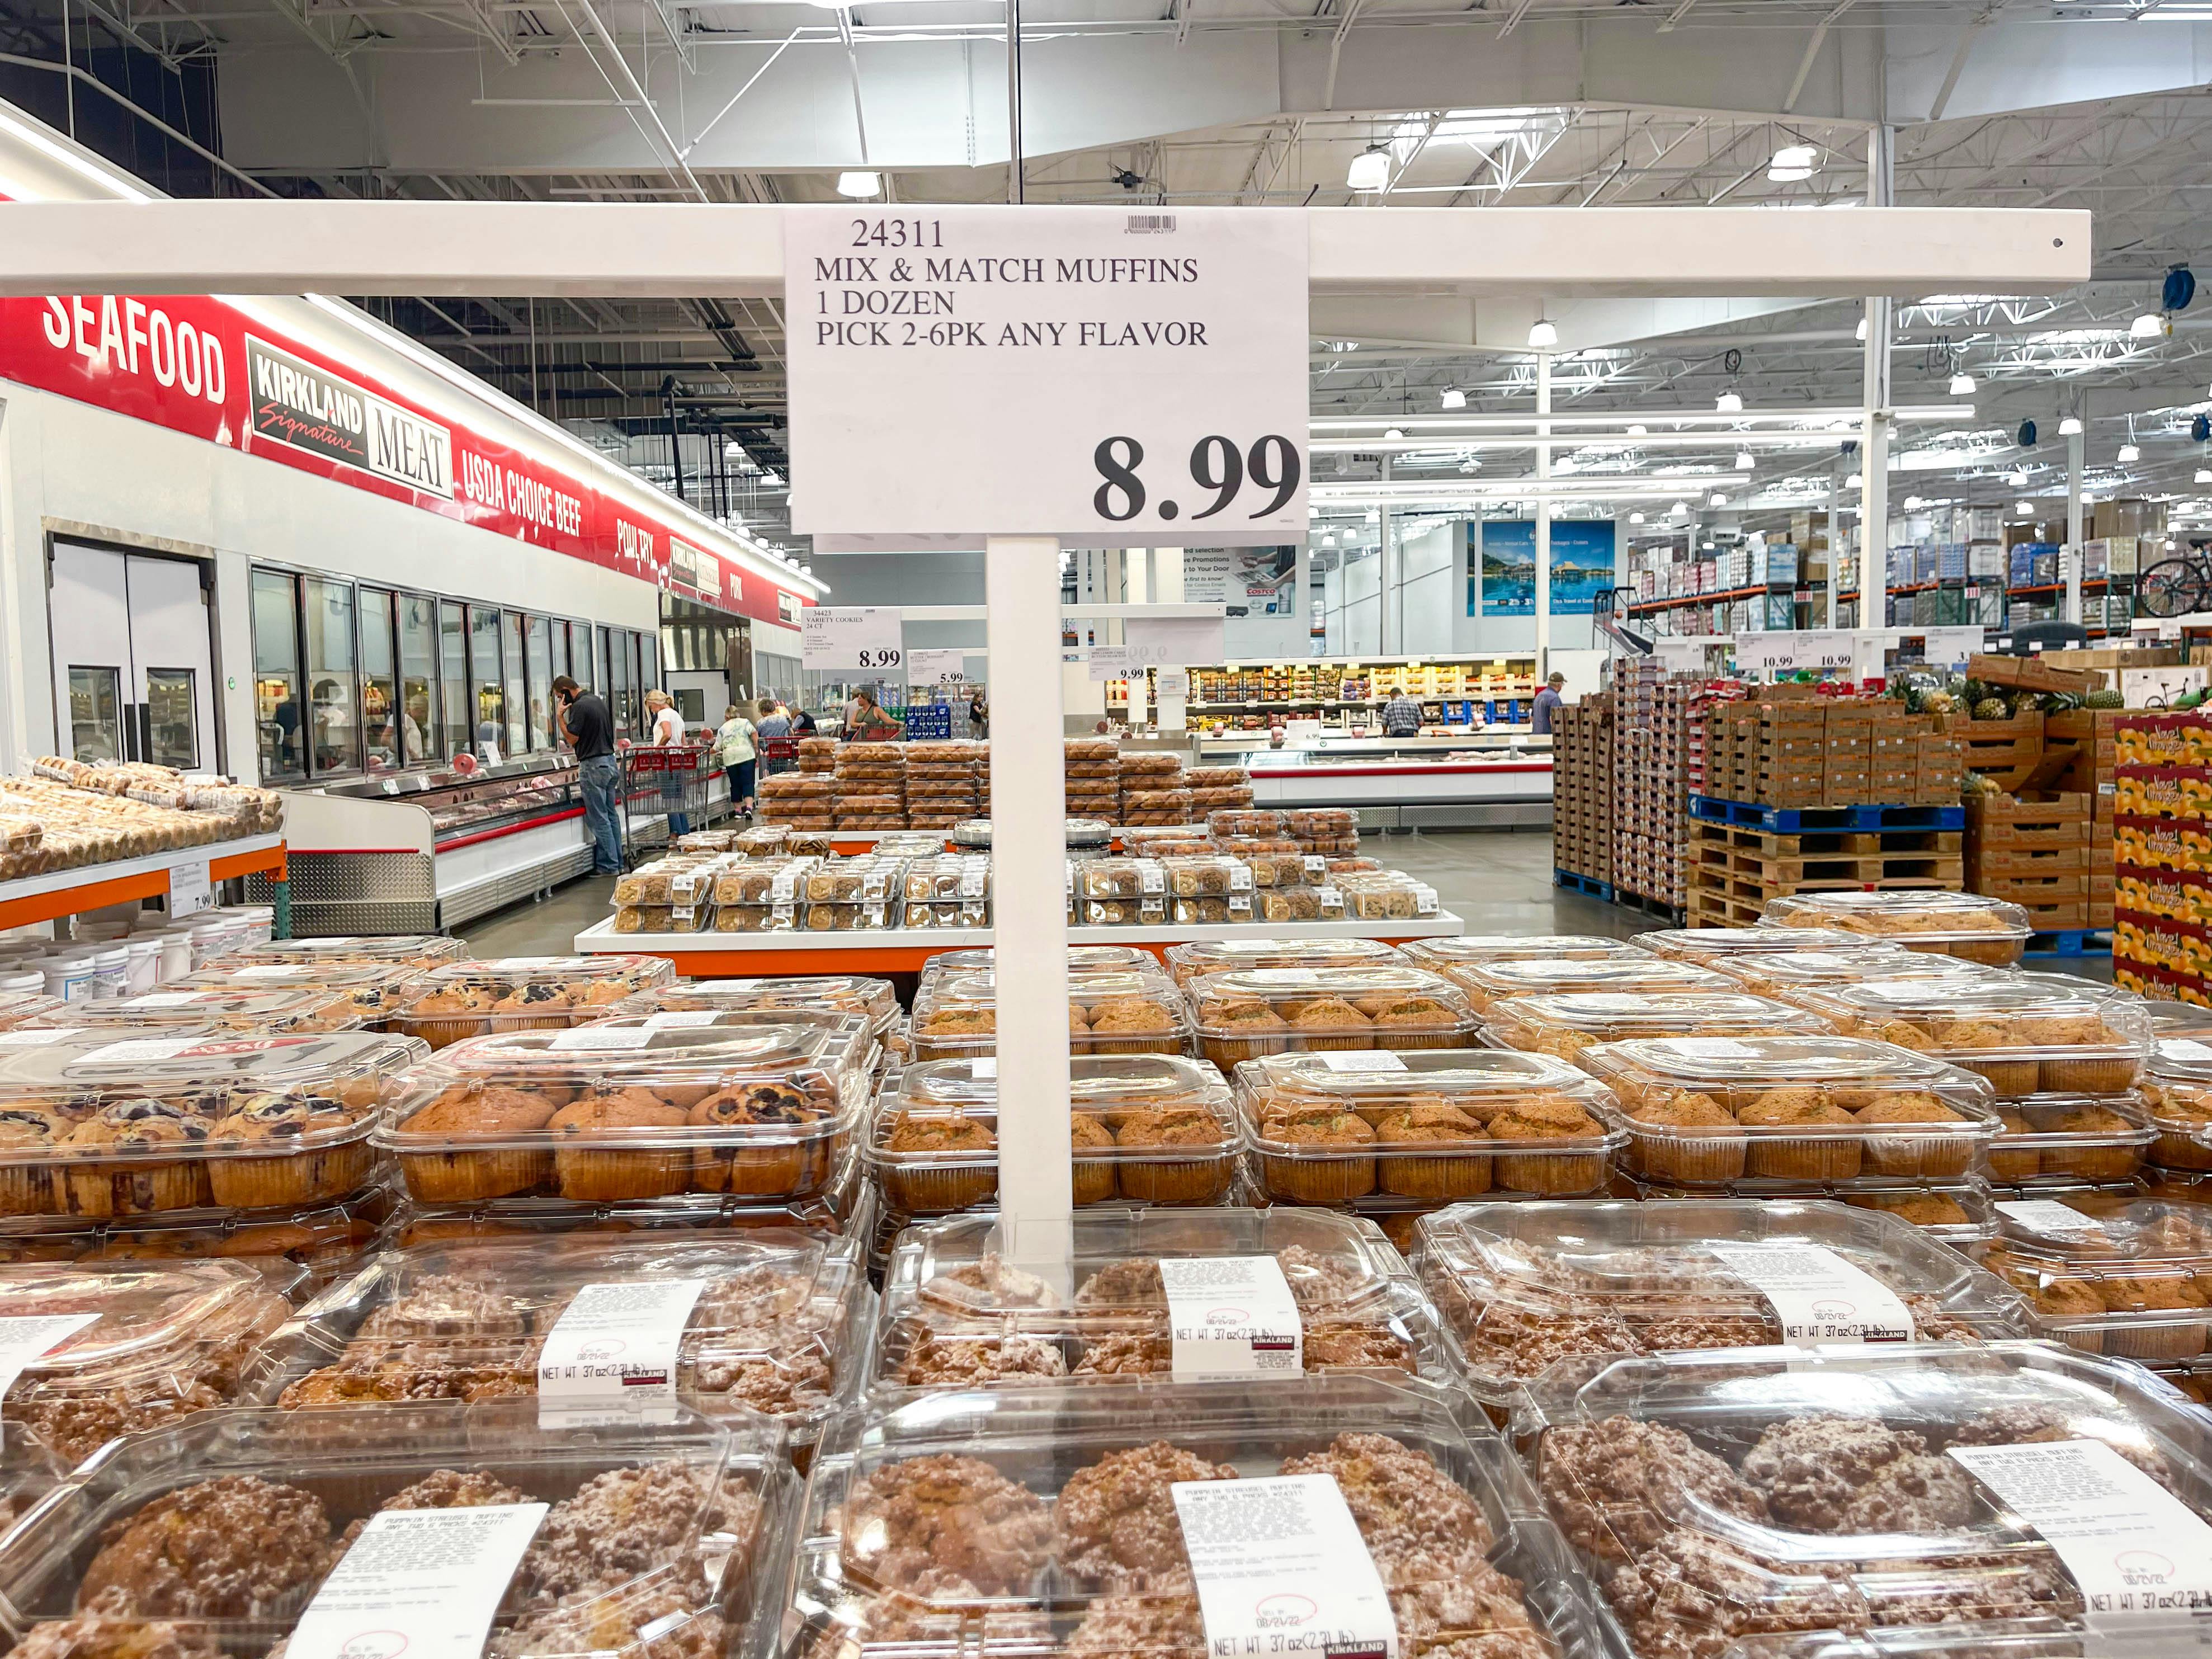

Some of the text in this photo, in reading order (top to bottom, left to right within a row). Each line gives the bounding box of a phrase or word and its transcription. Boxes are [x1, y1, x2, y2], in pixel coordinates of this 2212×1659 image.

[852, 219, 942, 248] 24311
[814, 257, 1199, 282] MIX & MATCH MUFFINS
[818, 290, 954, 315] 1 DOZEN
[817, 321, 1209, 346] PICK 2-6PK ANY FLAVOR
[43, 295, 226, 405] SEAFOOD
[256, 354, 362, 435] KIRKLAND
[258, 402, 364, 456] Signature
[374, 407, 444, 489] MEAT
[1093, 435, 1301, 522] 8.99
[462, 449, 582, 537] USDA CHOICE BEEF
[616, 518, 654, 564] POULTRY
[730, 573, 743, 601] PORK
[859, 650, 900, 667] 8.99
[1763, 657, 1793, 667] 10.99
[1821, 656, 1851, 666] 10.99
[940, 673, 963, 683] 5.99
[1120, 669, 1144, 679] 9.99
[195, 894, 210, 910] 7.99
[1177, 1328, 1192, 1340] NET
[1198, 1328, 1209, 1340] WT
[1215, 1328, 1225, 1340] 37
[1787, 1326, 1803, 1338] NET
[1809, 1326, 1819, 1337] WT
[1826, 1326, 1836, 1337] 37
[542, 1366, 559, 1379] NET
[565, 1366, 577, 1378] WT
[583, 1365, 594, 1378] 37
[2027, 1455, 2053, 1464] PACKS
[428, 1514, 470, 1523] STREUSEL
[2090, 1594, 2112, 1611] NET
[2121, 1593, 2134, 1610] WT
[2142, 1592, 2156, 1609] 37
[1256, 1616, 1300, 1628] 08/21/22
[1214, 1637, 1236, 1657] NET
[1246, 1636, 1260, 1654] WT
[1270, 1634, 1284, 1652] 37
[1327, 1642, 1384, 1655] KIRKLAND
